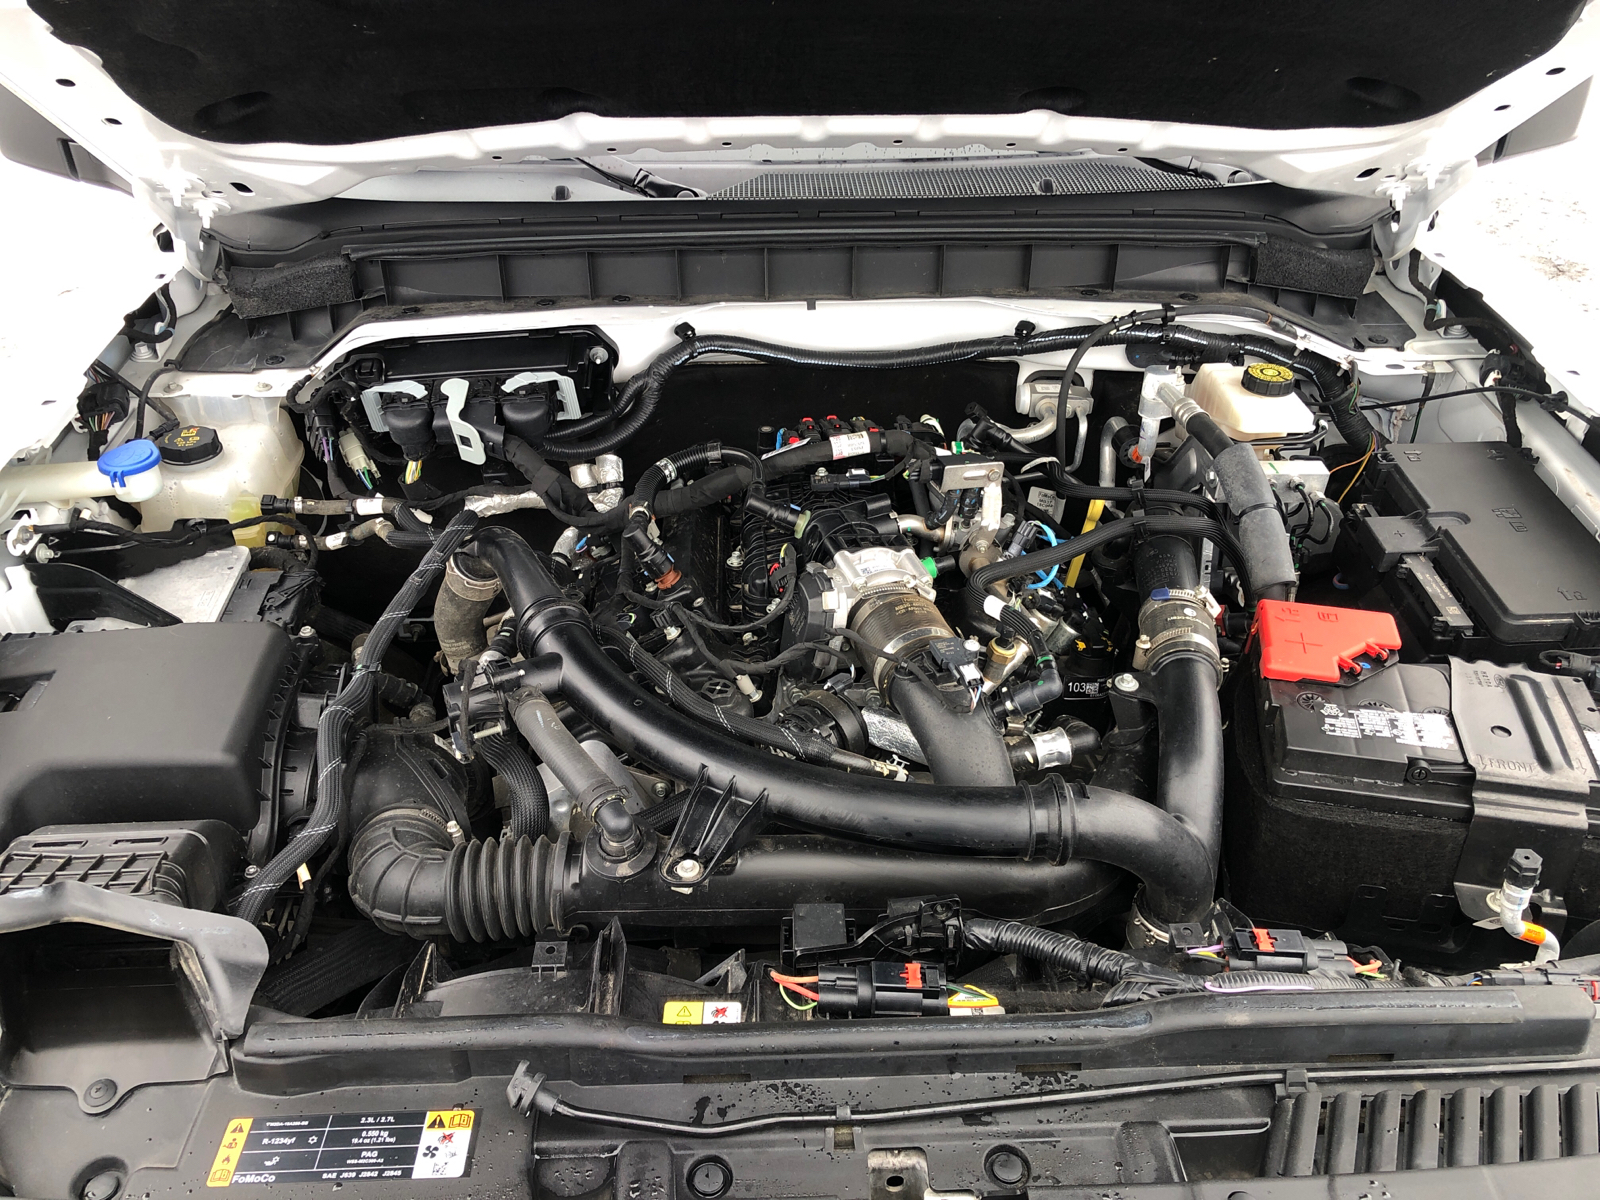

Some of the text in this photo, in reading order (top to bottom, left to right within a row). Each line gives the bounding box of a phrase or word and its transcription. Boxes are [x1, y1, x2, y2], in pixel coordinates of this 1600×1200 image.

[1068, 682, 1086, 692] 103
[1488, 757, 1534, 774] FRONT
[380, 1130, 389, 1138] kg
[261, 1136, 296, 1145] R-1234yf
[231, 1174, 276, 1184] FoMoCo
